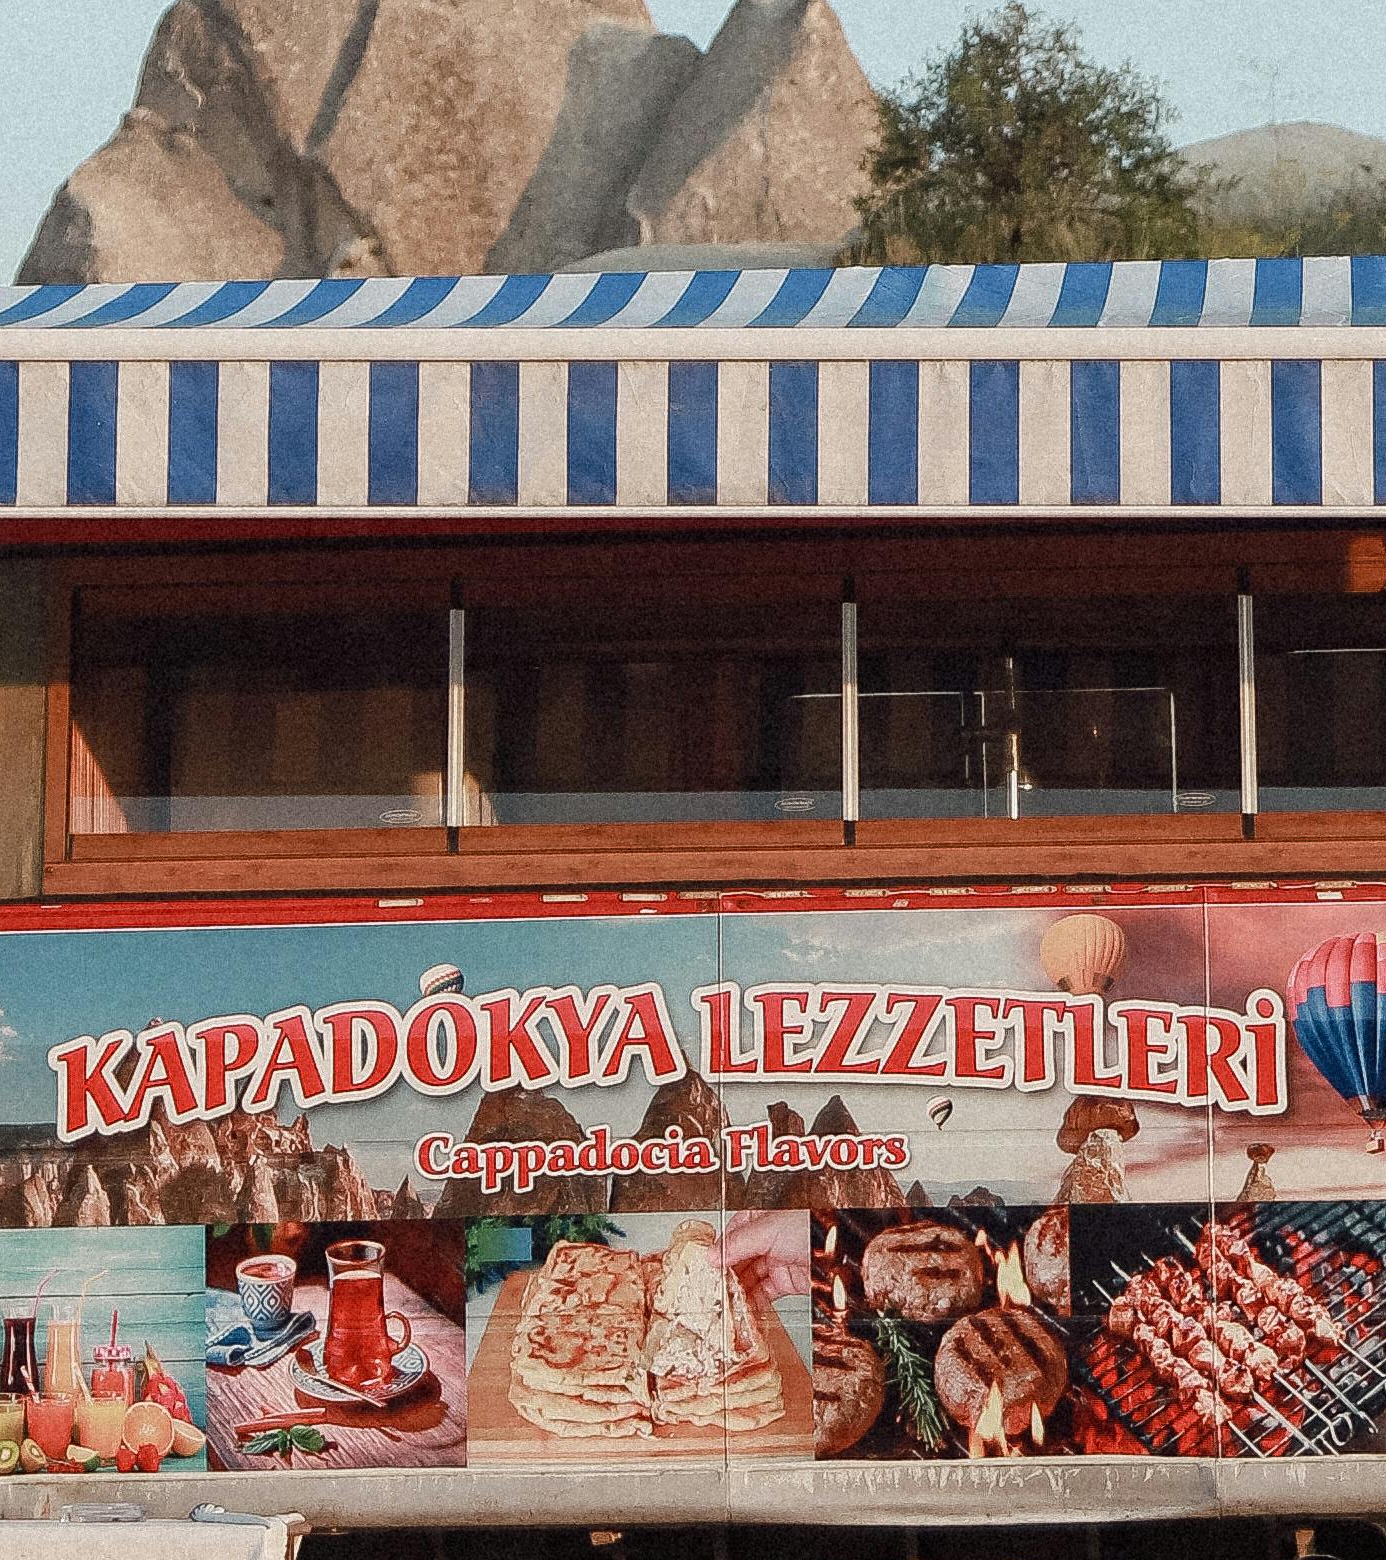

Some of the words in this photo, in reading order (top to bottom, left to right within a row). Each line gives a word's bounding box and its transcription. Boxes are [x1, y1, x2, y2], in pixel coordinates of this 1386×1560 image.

[53, 987, 678, 1136] KAPADOKYA
[416, 1126, 715, 1192] Cappadocia
[725, 1121, 908, 1170] Flavors
